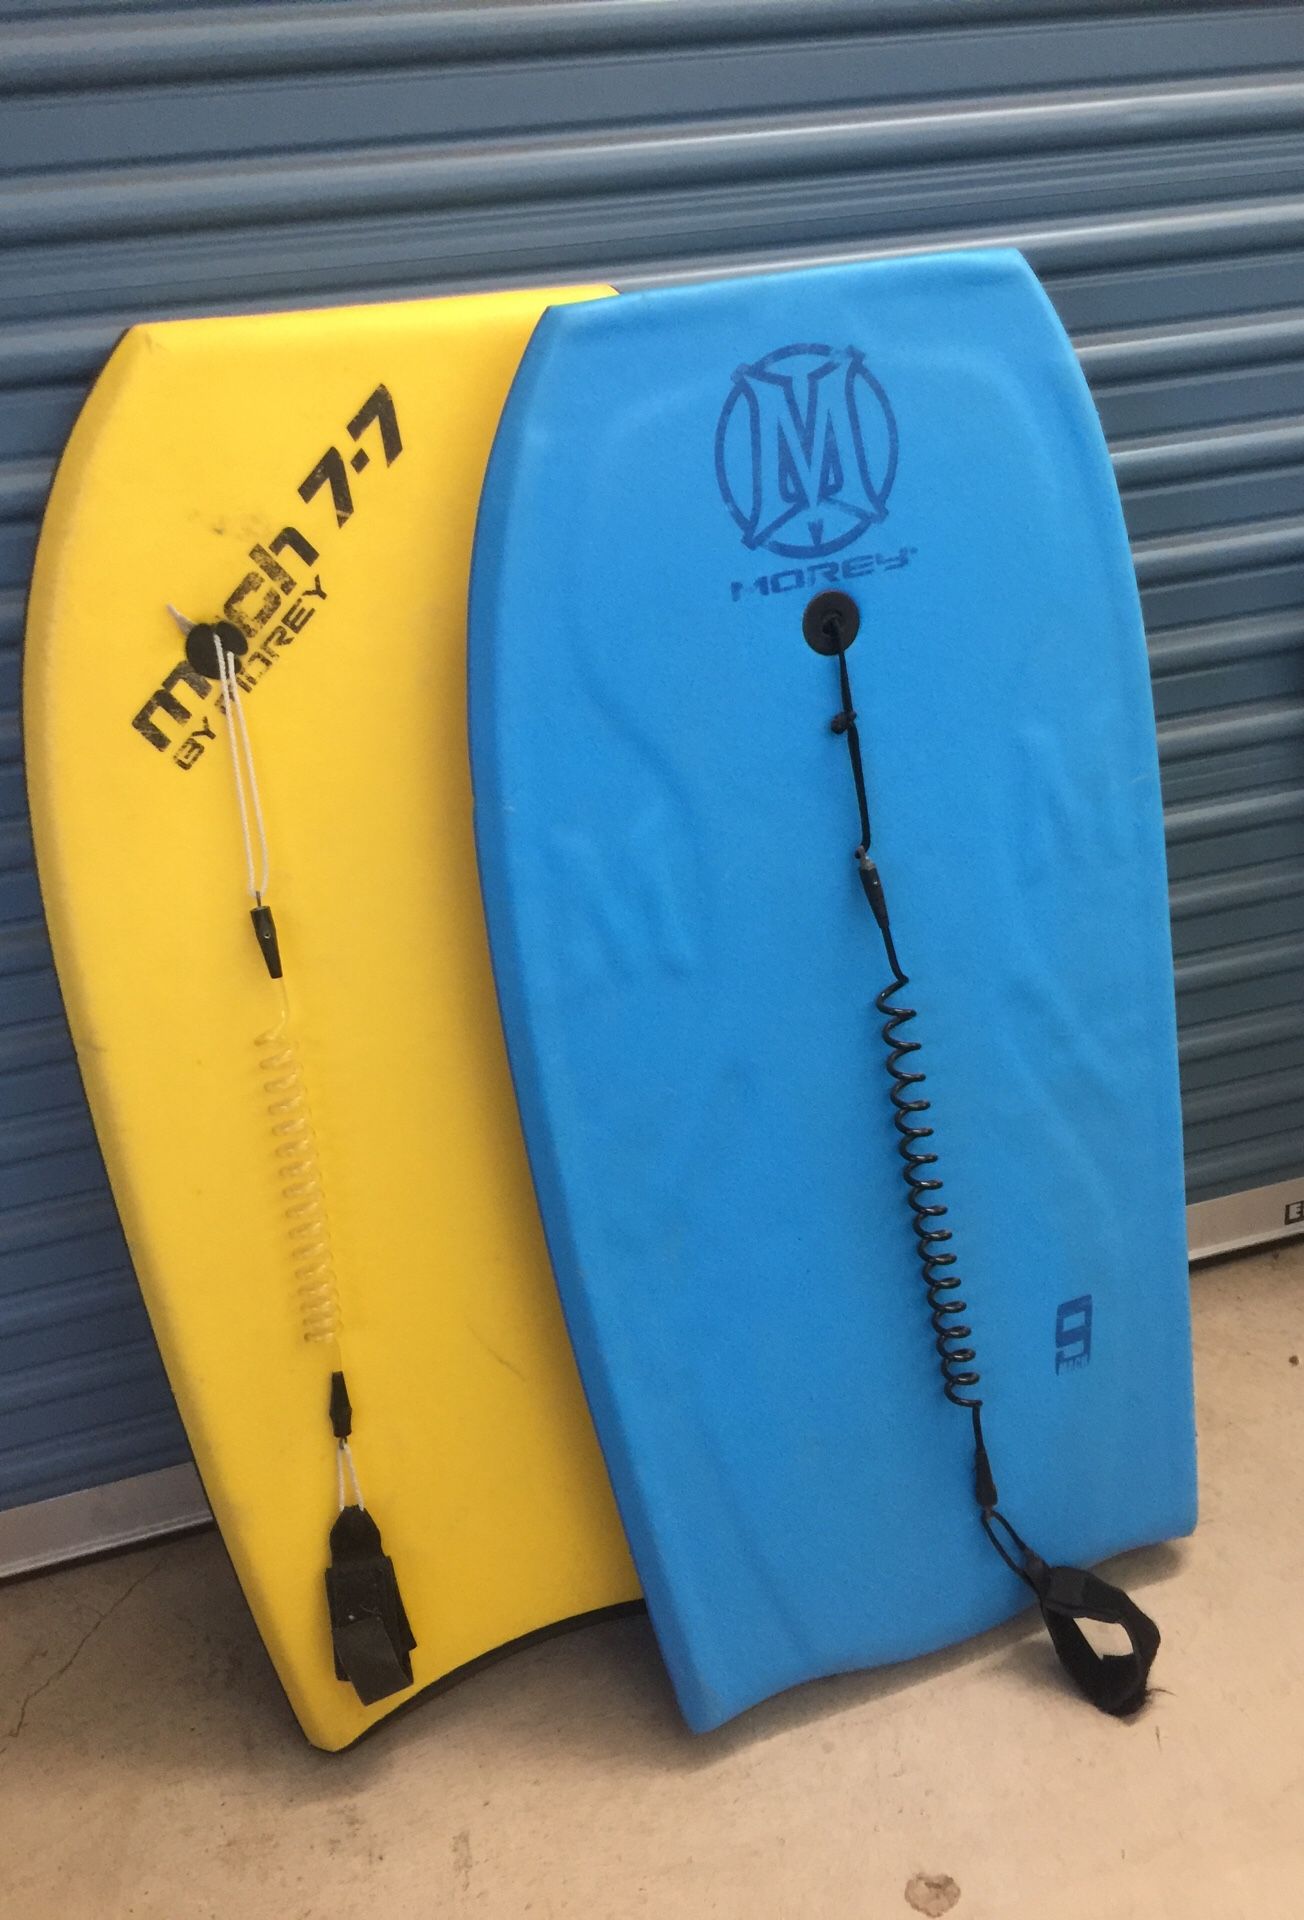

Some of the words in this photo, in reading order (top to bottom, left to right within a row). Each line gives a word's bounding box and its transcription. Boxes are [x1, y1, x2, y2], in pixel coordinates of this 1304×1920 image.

[730, 549, 909, 601] MOREY
[131, 527, 320, 752] mch
[173, 716, 216, 770] BY
